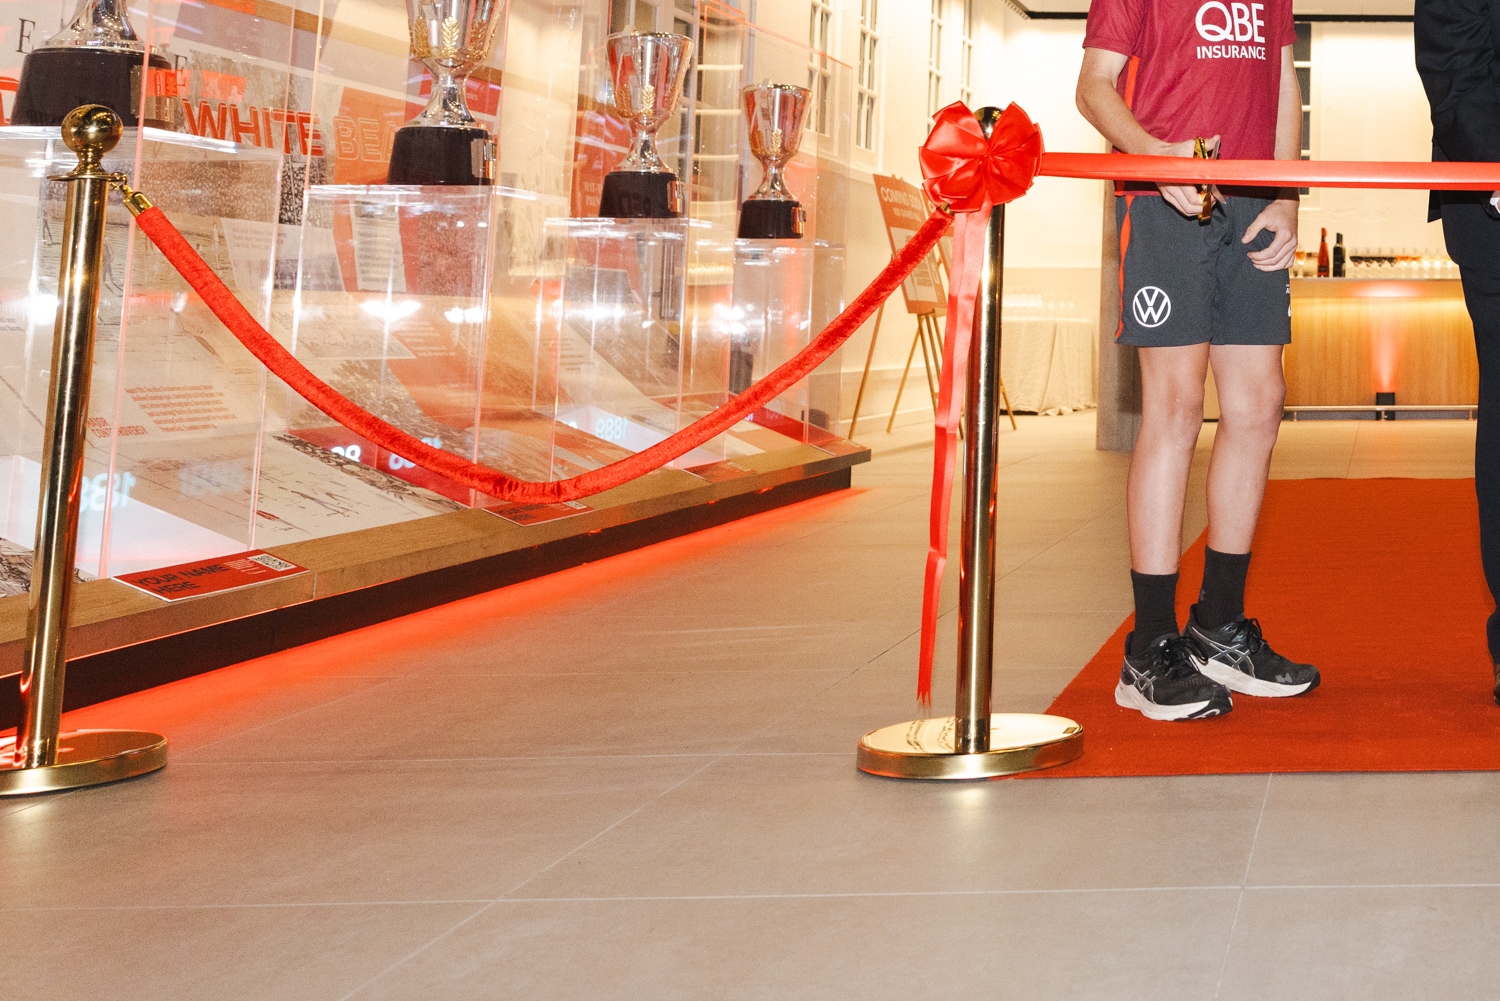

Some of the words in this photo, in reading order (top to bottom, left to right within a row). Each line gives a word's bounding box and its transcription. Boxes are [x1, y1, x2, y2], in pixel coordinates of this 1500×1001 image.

[1195, 1, 1266, 44] QBE
[1196, 45, 1266, 61] INSURANCE
[182, 98, 324, 157] WHITE
[132, 573, 180, 587] YOUR
[182, 564, 231, 579] NAME
[151, 581, 201, 595] HERE
